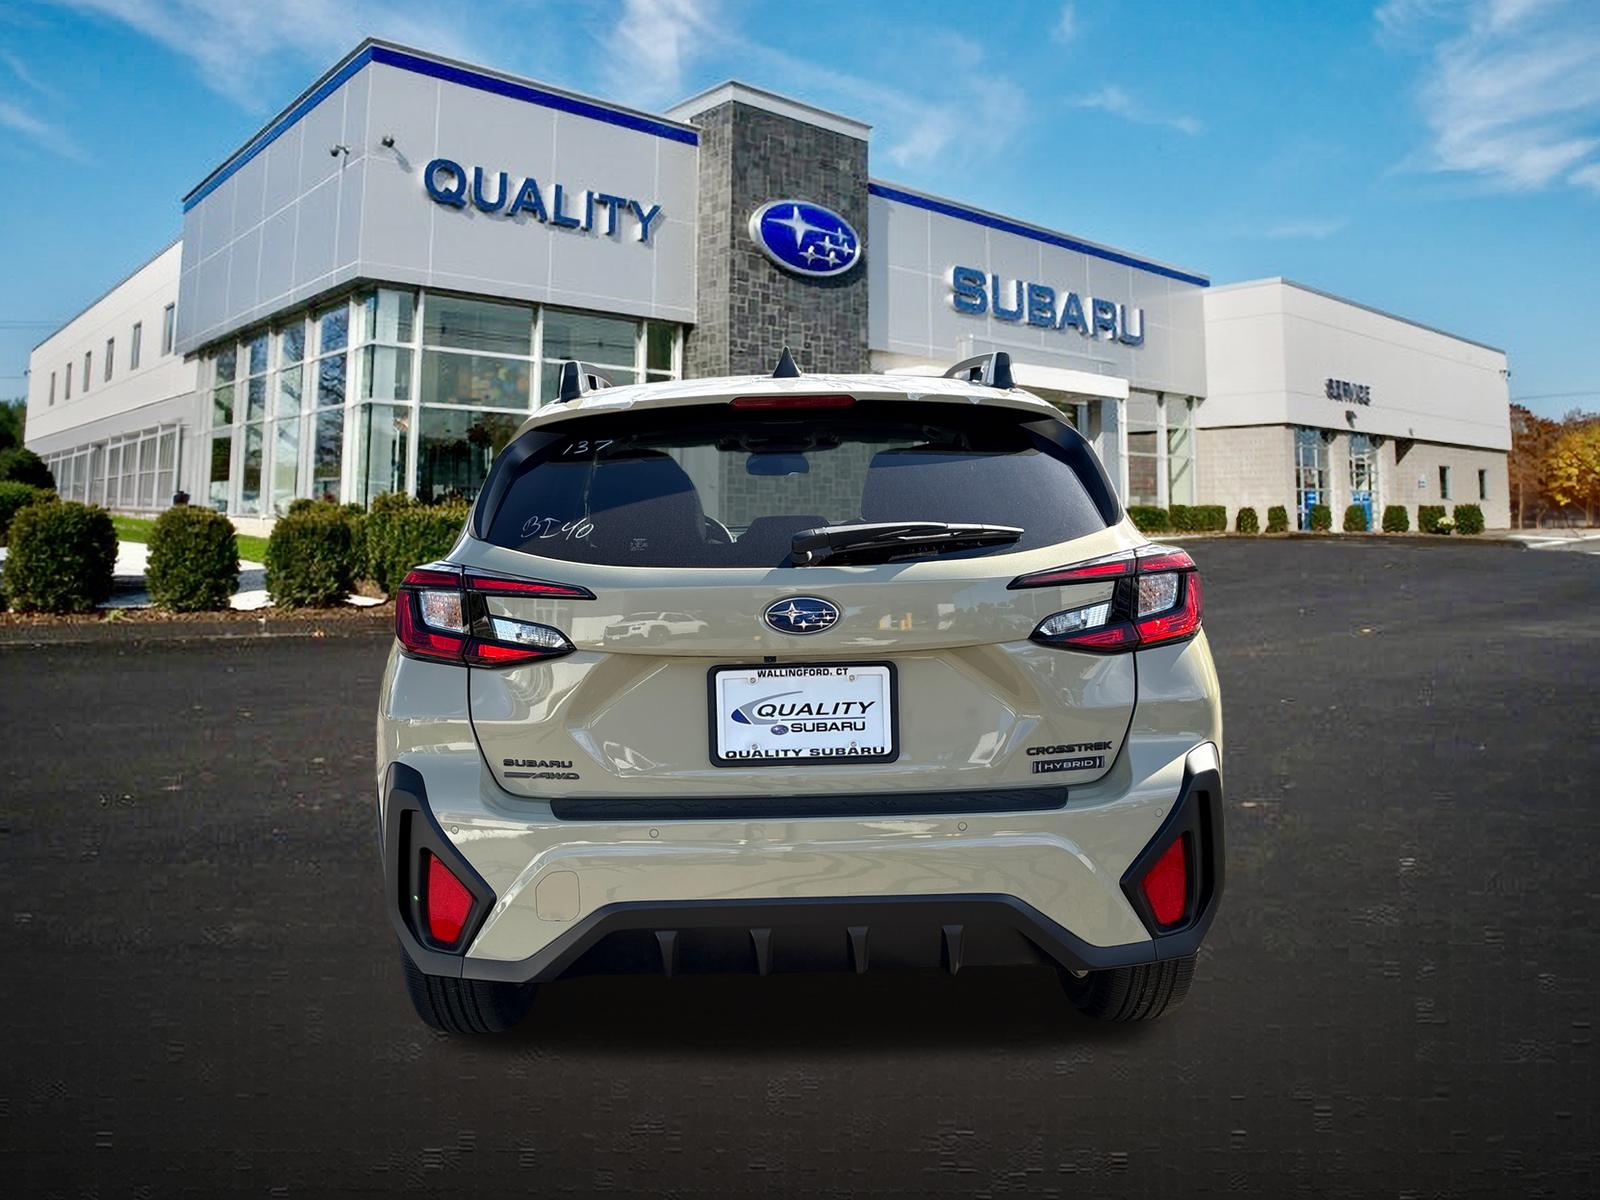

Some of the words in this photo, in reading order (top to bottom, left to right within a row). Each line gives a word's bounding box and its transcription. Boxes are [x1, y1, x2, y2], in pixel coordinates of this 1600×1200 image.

[424, 158, 661, 242] QUALITY
[951, 265, 1145, 346] SUBARU
[562, 440, 614, 455] 137
[836, 667, 849, 676] CT
[757, 701, 875, 718] QUALITY
[790, 721, 866, 733] SUBARU
[725, 748, 801, 759] QUALITY
[809, 746, 885, 756] SUBARU
[1026, 741, 1113, 756] CROSSTREK
[503, 758, 573, 768] SUBARU
[1044, 760, 1094, 770] HYBRID
[532, 772, 580, 780] AWD
